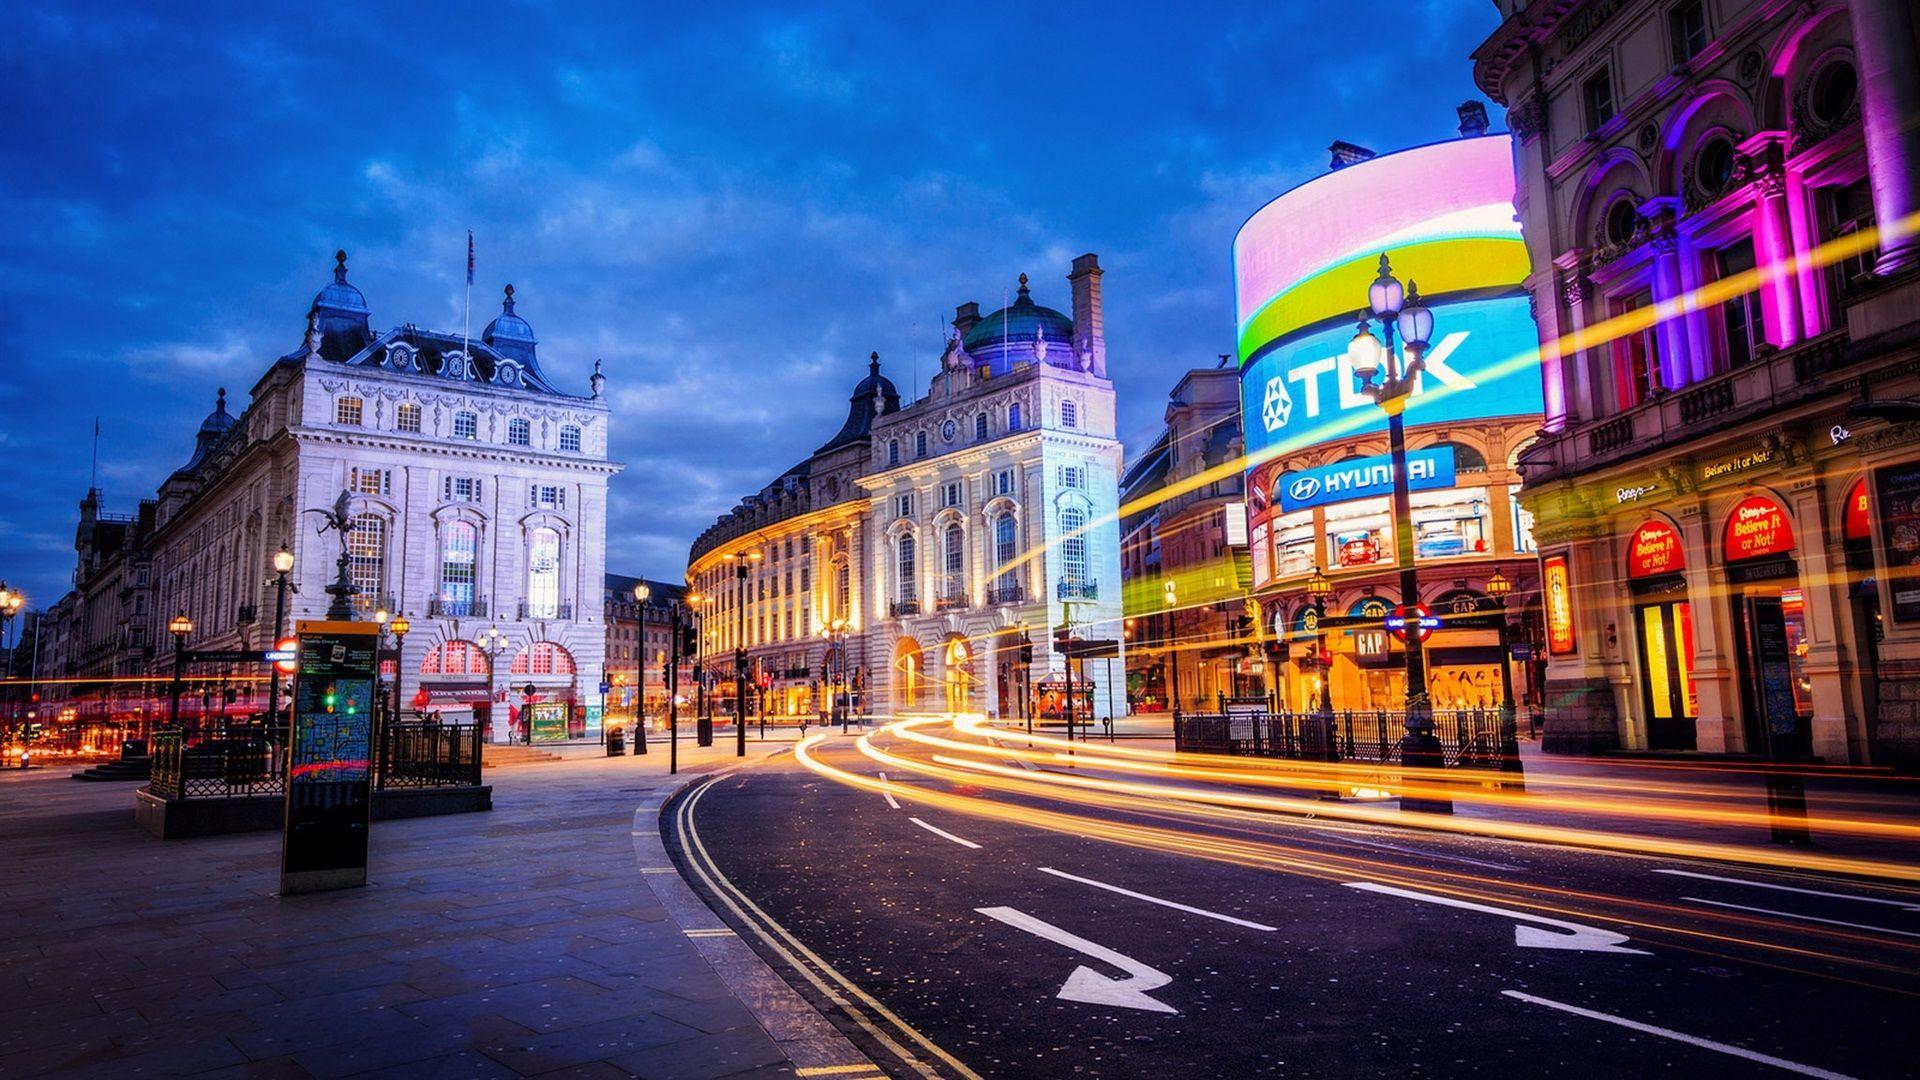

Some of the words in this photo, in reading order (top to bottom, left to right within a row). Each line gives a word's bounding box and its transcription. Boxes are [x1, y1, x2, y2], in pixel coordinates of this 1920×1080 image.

[1288, 331, 1477, 417] TDK
[1704, 463, 1731, 479] Believe
[1733, 456, 1741, 471] It
[1742, 457, 1751, 468] or
[1752, 450, 1770, 466] Not!
[1324, 458, 1436, 494] HYUNAI
[1734, 520, 1769, 537] Believe
[1771, 514, 1781, 529] It
[1636, 542, 1664, 557] Believe
[1665, 537, 1674, 550] It
[1741, 539, 1752, 550] or
[1754, 530, 1775, 548] Not!
[1642, 558, 1651, 569] or
[1652, 551, 1670, 567] Not!
[1453, 602, 1476, 614] GAP
[1388, 618, 1438, 627] UNDOUND
[1358, 633, 1382, 655] GAP
